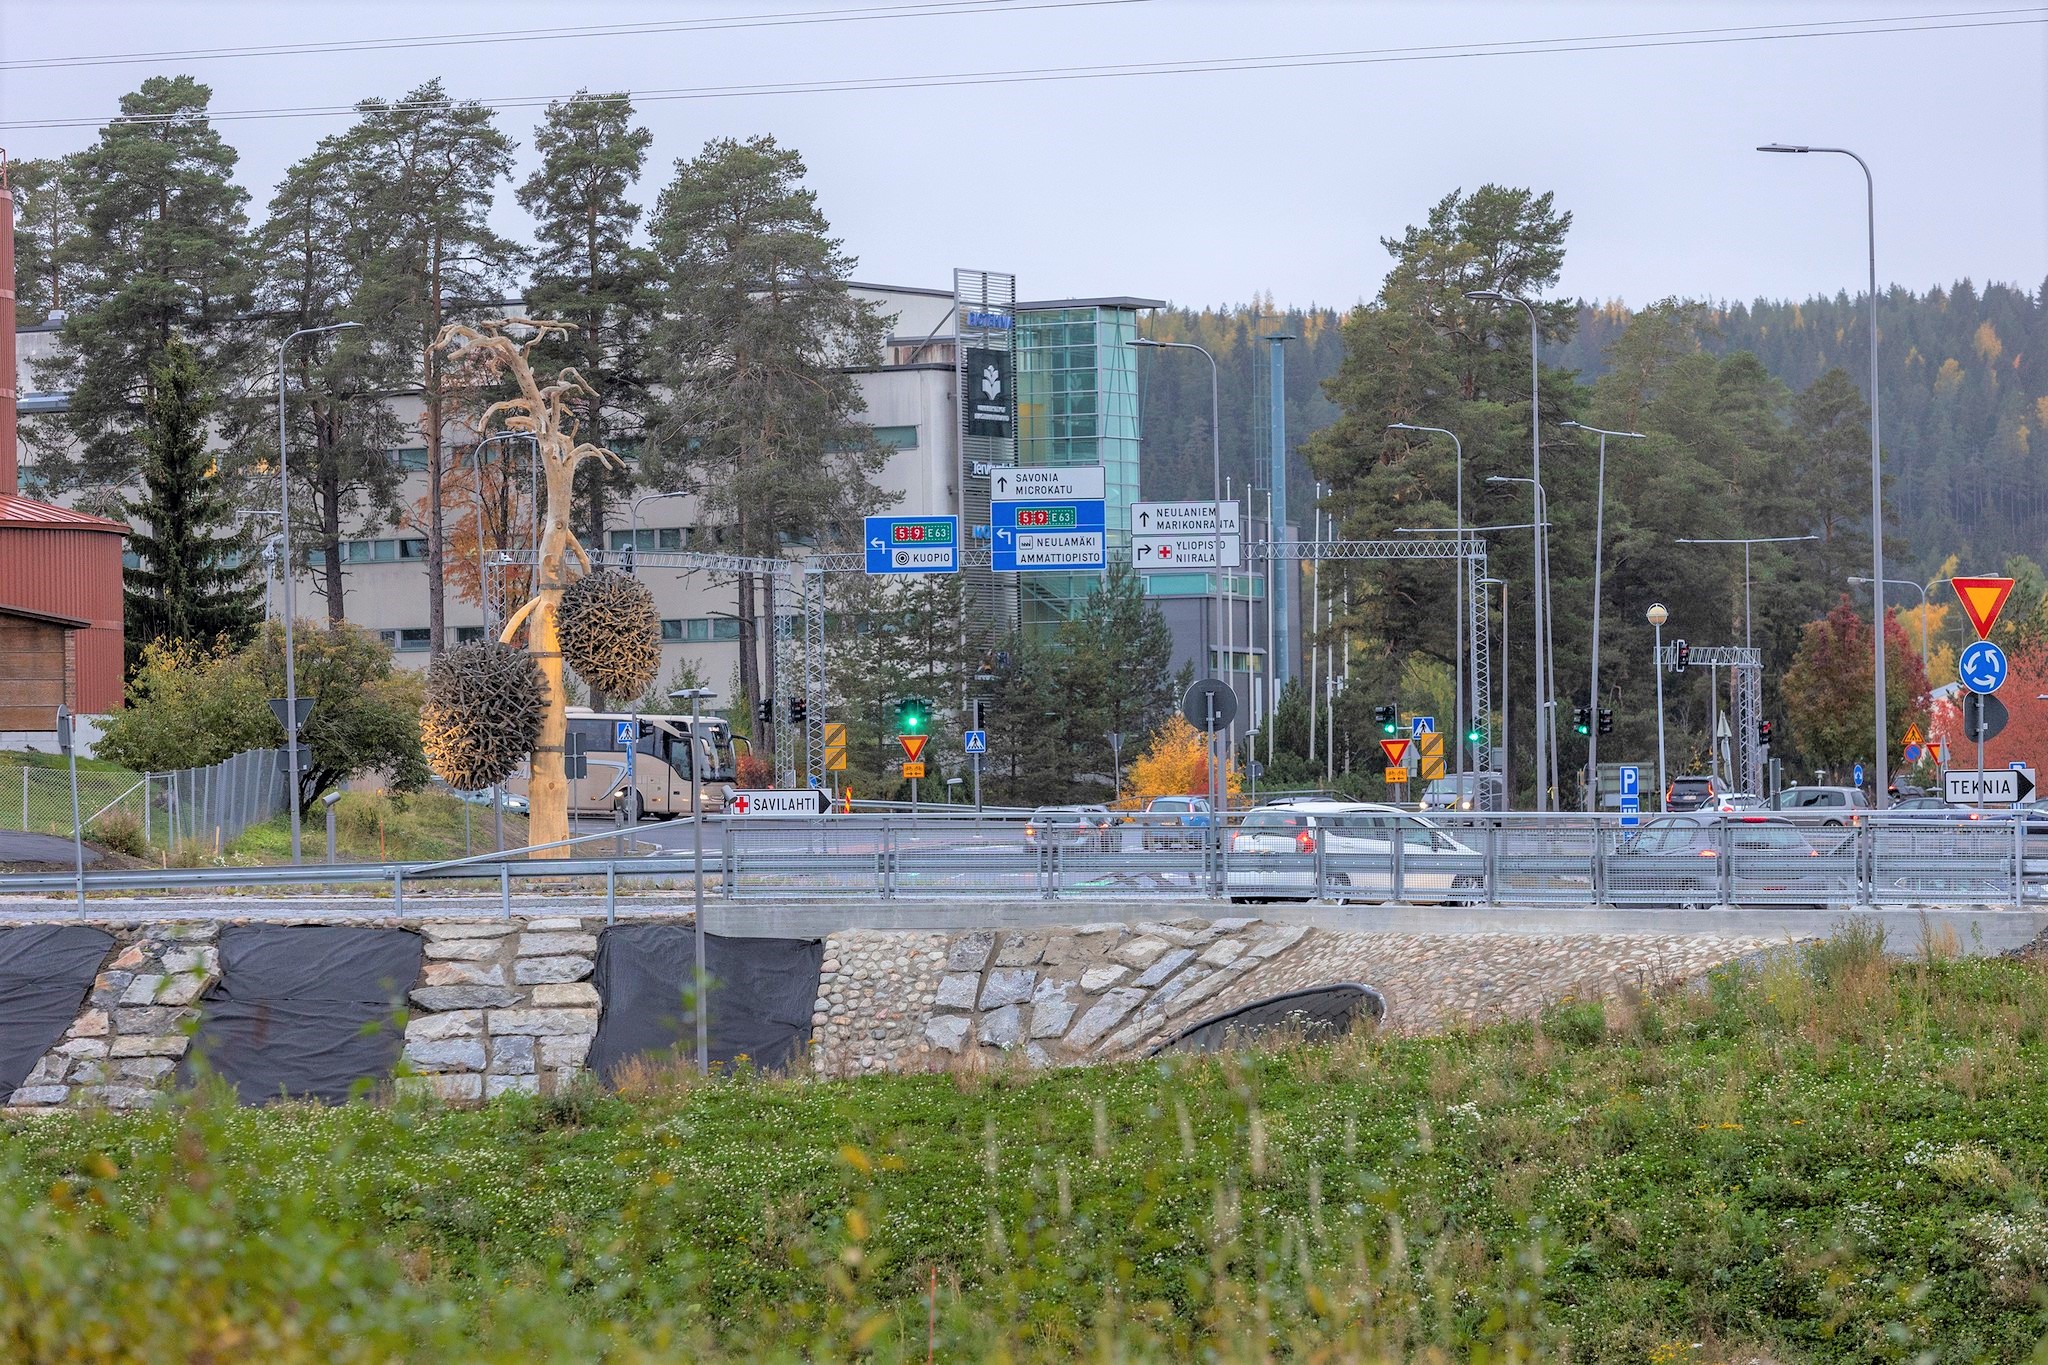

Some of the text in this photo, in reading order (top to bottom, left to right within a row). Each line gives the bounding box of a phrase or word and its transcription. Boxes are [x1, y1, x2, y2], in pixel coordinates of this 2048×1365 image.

[1016, 473, 1058, 482] SAVONIA
[1016, 485, 1072, 494] MICROKATU
[1157, 507, 1217, 517] NEULANIEM
[1023, 513, 1070, 522] 5 9 E 63
[899, 528, 946, 538] 5 9 E 63
[1037, 536, 1095, 547] NEULAMÄKI
[913, 553, 950, 562] KUOPIO
[1020, 552, 1100, 563] AMMATTIOPISTO
[1176, 553, 1215, 563] NIIRALA
[1624, 769, 1636, 793] P
[1951, 780, 2010, 794] TEKNIA
[753, 798, 815, 811] SAVILAHTI
